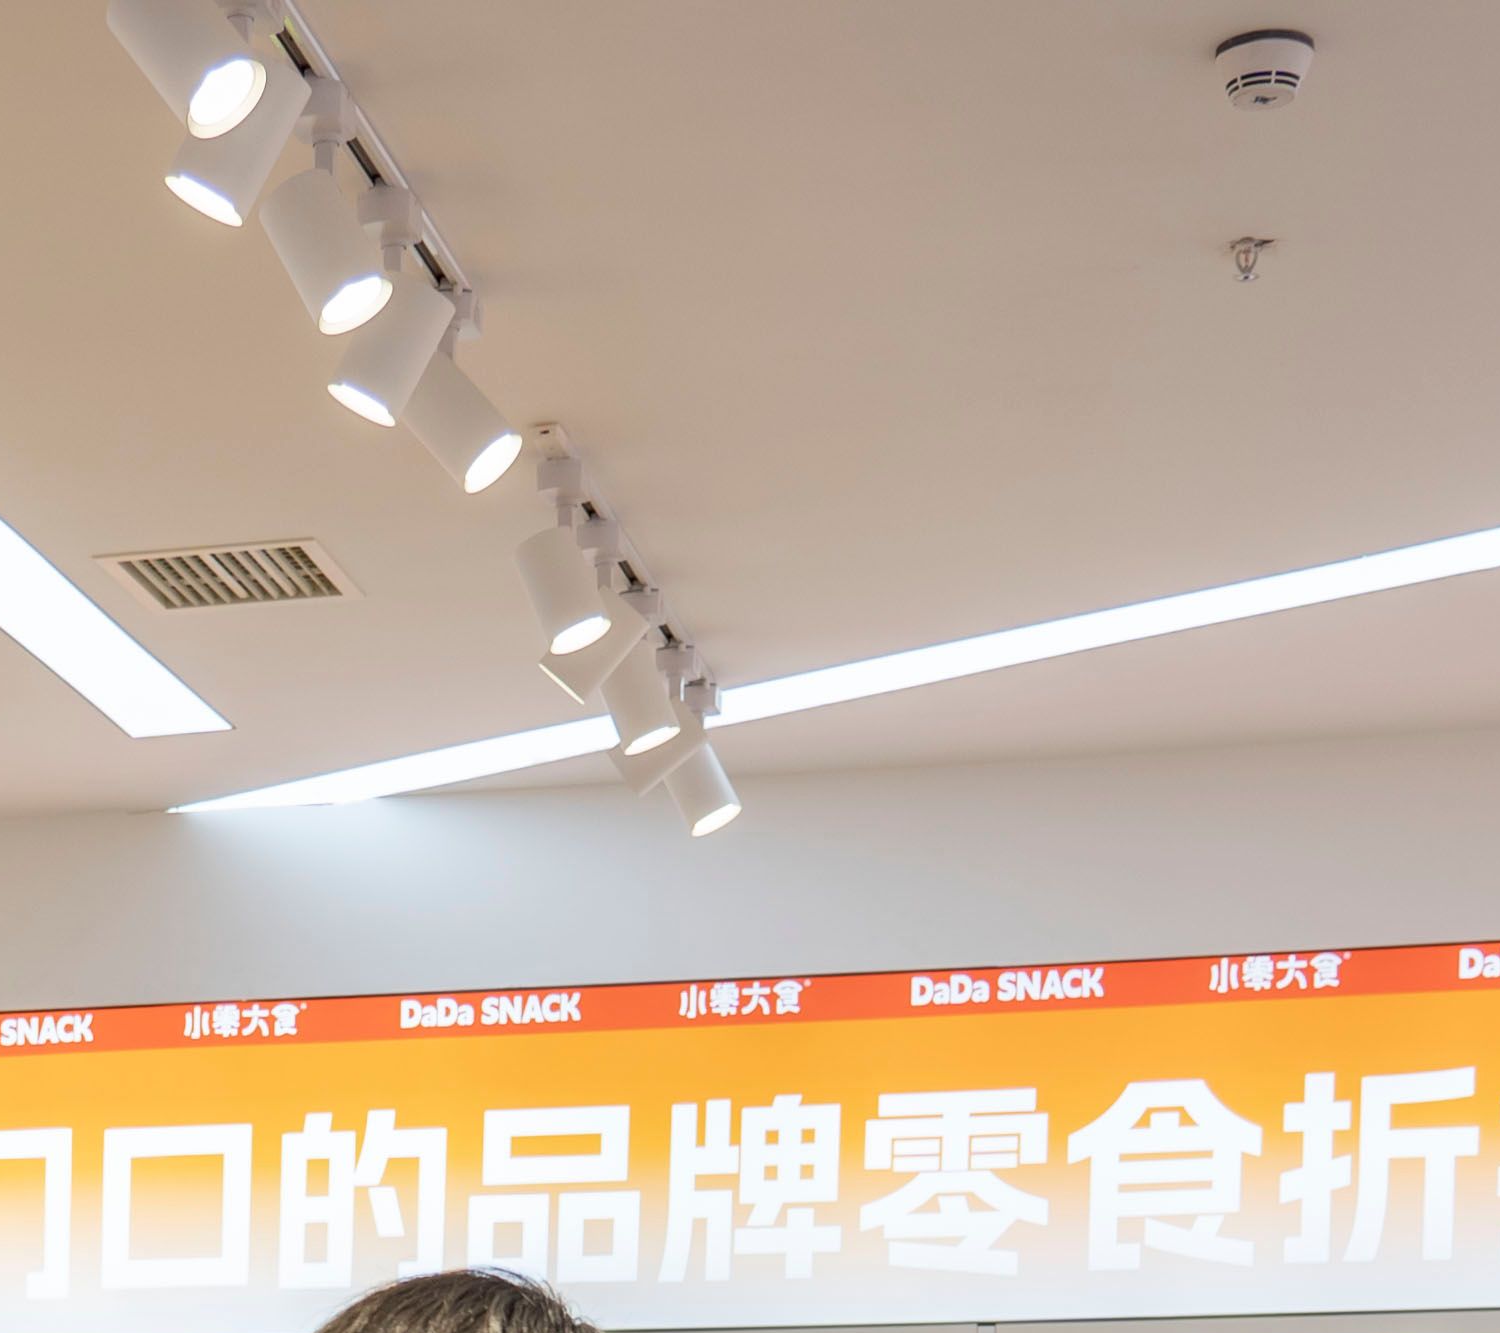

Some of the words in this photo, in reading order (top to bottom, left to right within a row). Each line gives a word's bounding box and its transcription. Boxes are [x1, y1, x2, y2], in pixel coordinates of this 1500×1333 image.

[911, 974, 990, 1006] DaDa
[996, 967, 1104, 1001] SNACK
[1209, 953, 1341, 993] 小零大食
[400, 998, 474, 1029] DaDa
[480, 992, 581, 1025] SNACK
[680, 980, 803, 1017] 小零大食
[0, 1014, 93, 1046] SNACK
[184, 1005, 298, 1039] 小零大食
